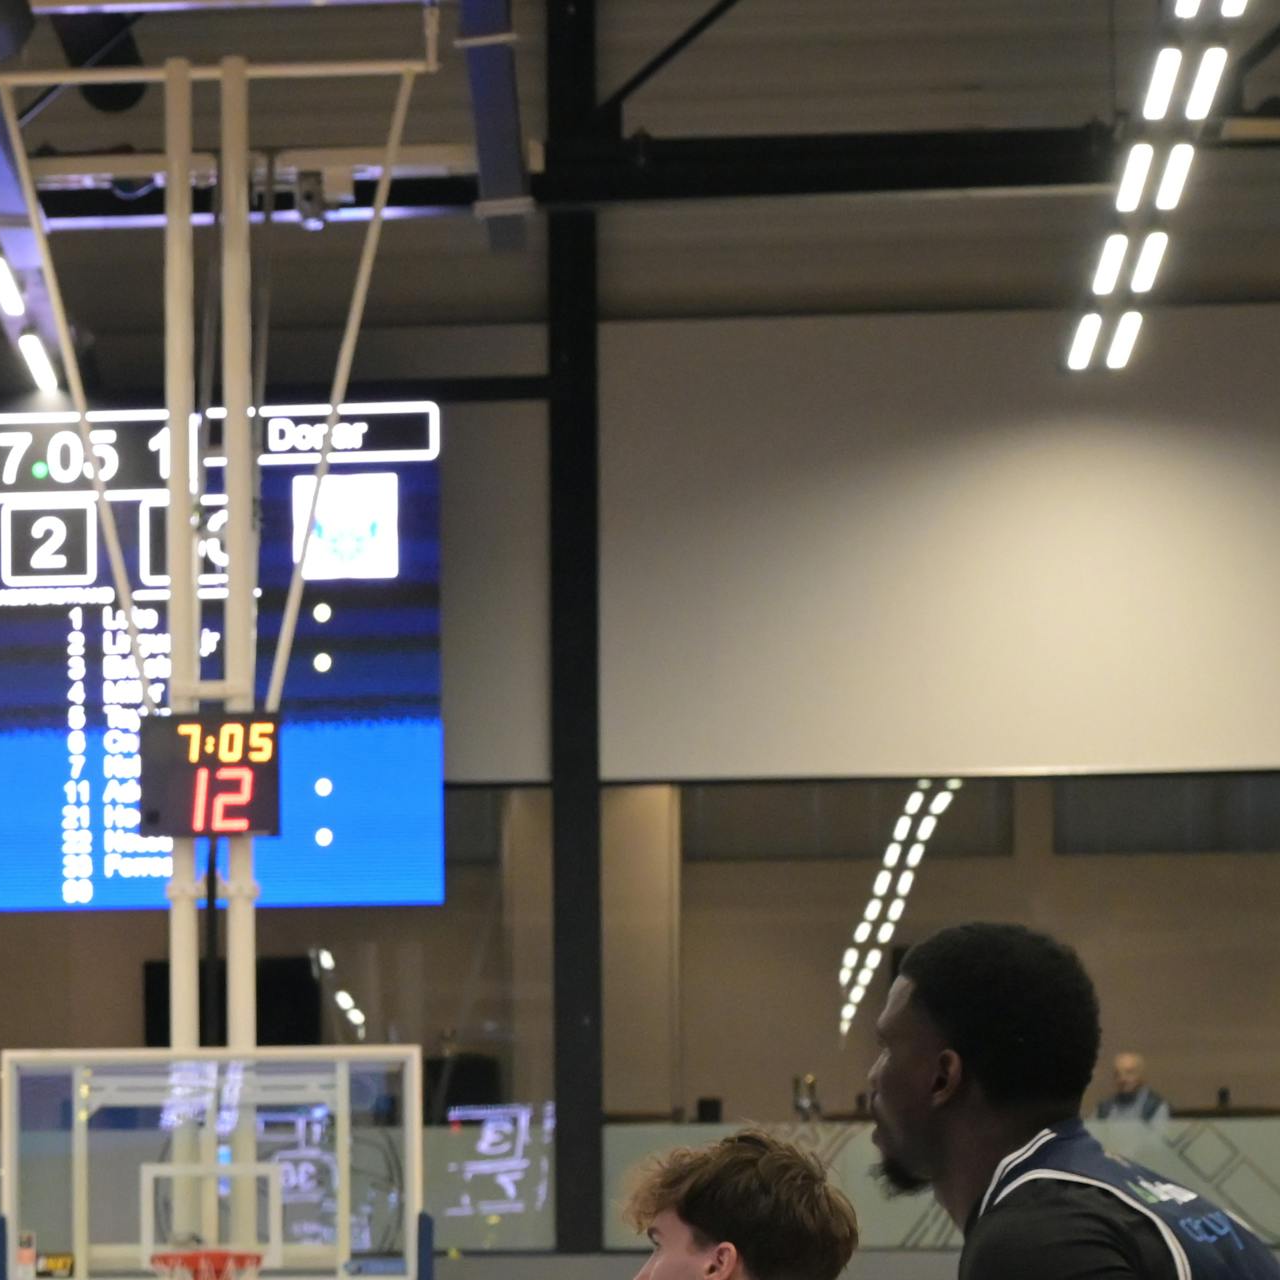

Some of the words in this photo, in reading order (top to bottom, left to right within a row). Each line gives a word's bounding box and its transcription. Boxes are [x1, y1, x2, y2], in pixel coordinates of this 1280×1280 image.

[30, 516, 67, 568] 2
[69, 606, 83, 631] 1
[177, 722, 274, 763] 7:05
[64, 780, 90, 804] 11
[192, 766, 254, 832] 12
